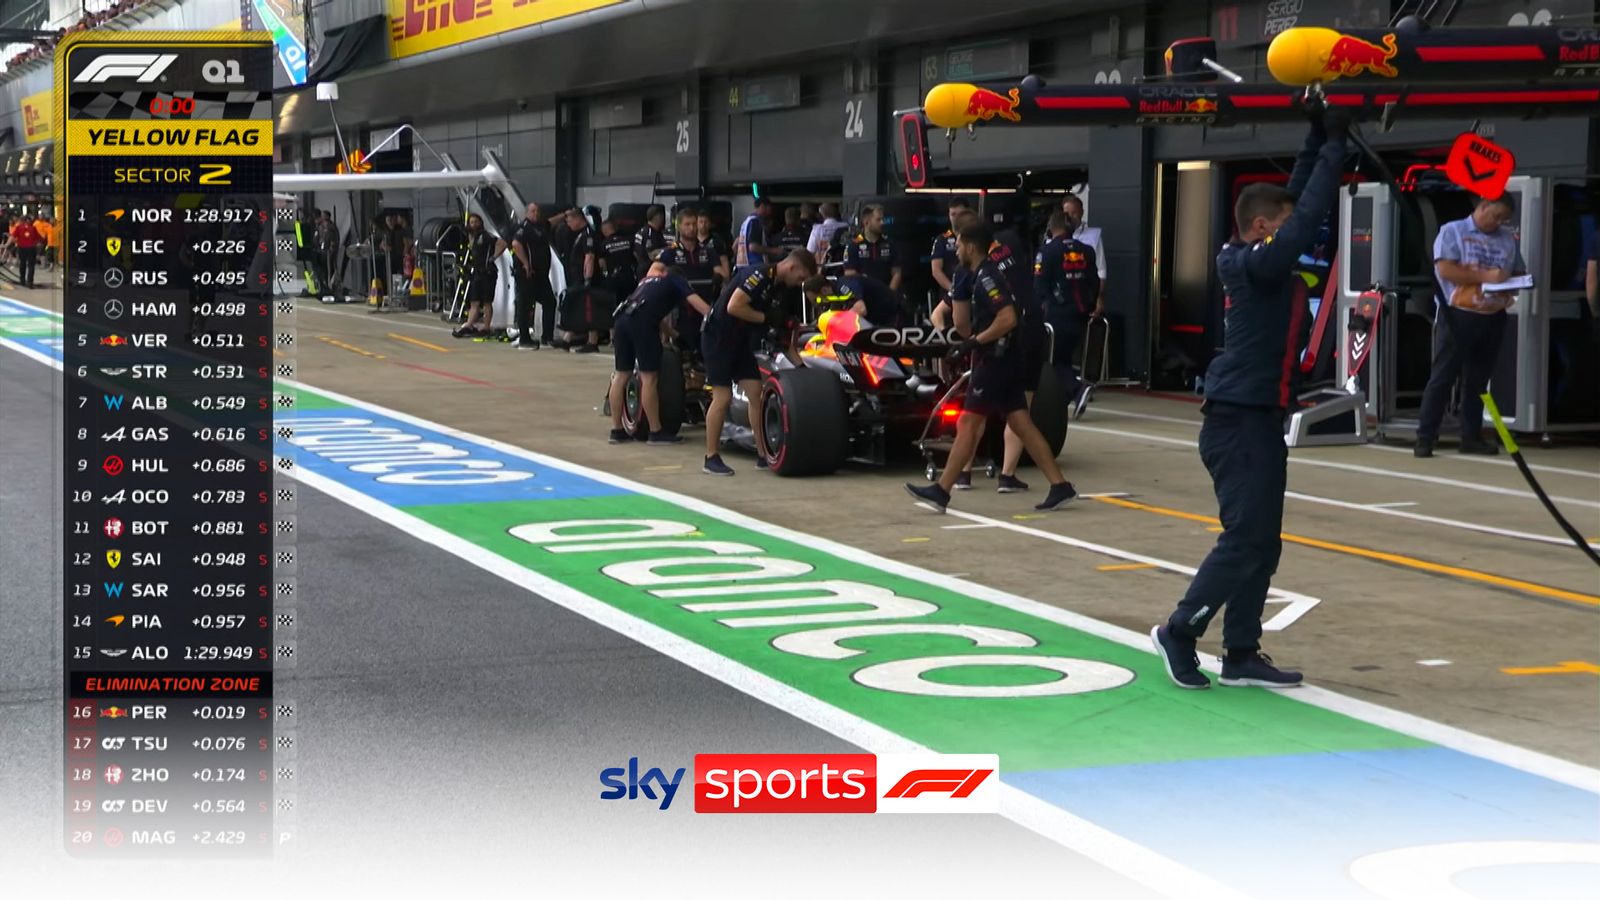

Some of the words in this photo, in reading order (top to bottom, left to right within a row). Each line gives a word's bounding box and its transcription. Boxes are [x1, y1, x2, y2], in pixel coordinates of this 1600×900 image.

[676, 120, 690, 153] 25
[844, 101, 864, 138] 24
[871, 327, 967, 345] ORAC
[506, 518, 1136, 698] aramco
